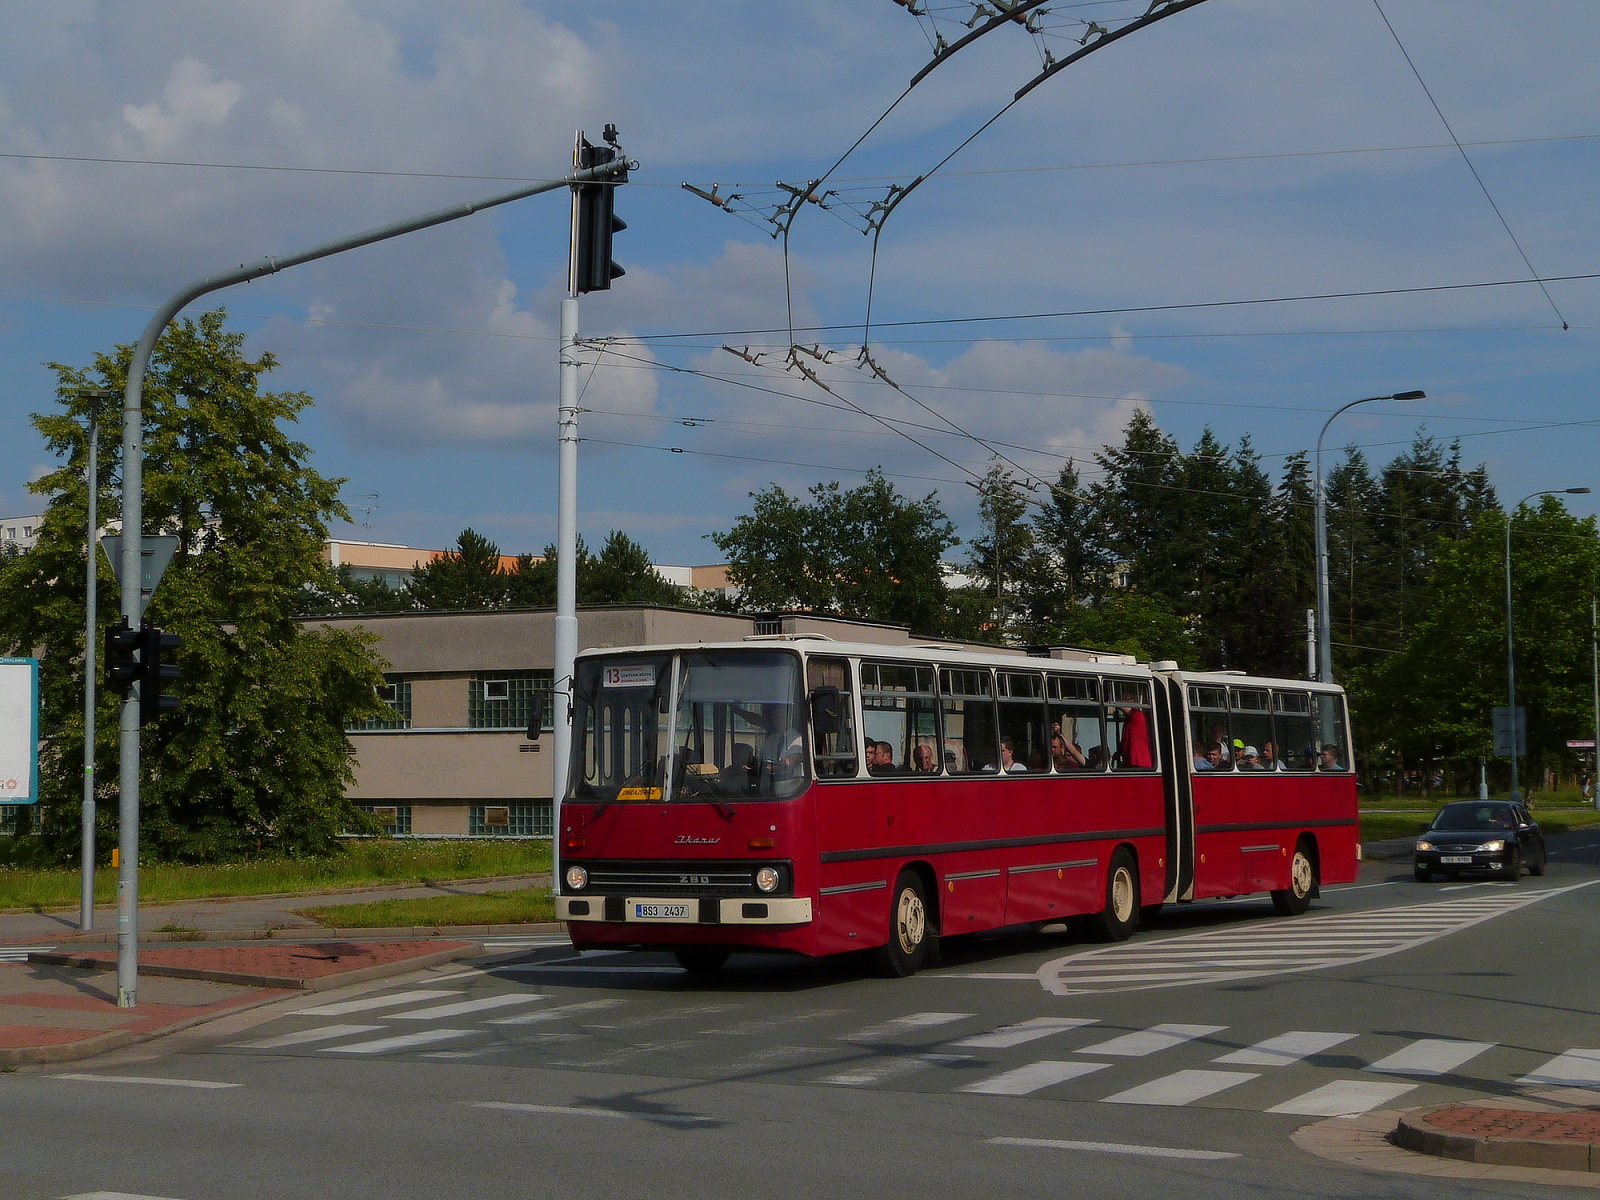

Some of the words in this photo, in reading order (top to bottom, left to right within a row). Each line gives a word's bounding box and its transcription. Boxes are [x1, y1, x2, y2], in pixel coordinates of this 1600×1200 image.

[606, 668, 620, 684] 13
[674, 835, 721, 844] Ikarus
[679, 876, 709, 884] 280
[643, 906, 658, 916] 8S3
[664, 906, 685, 916] 2437
